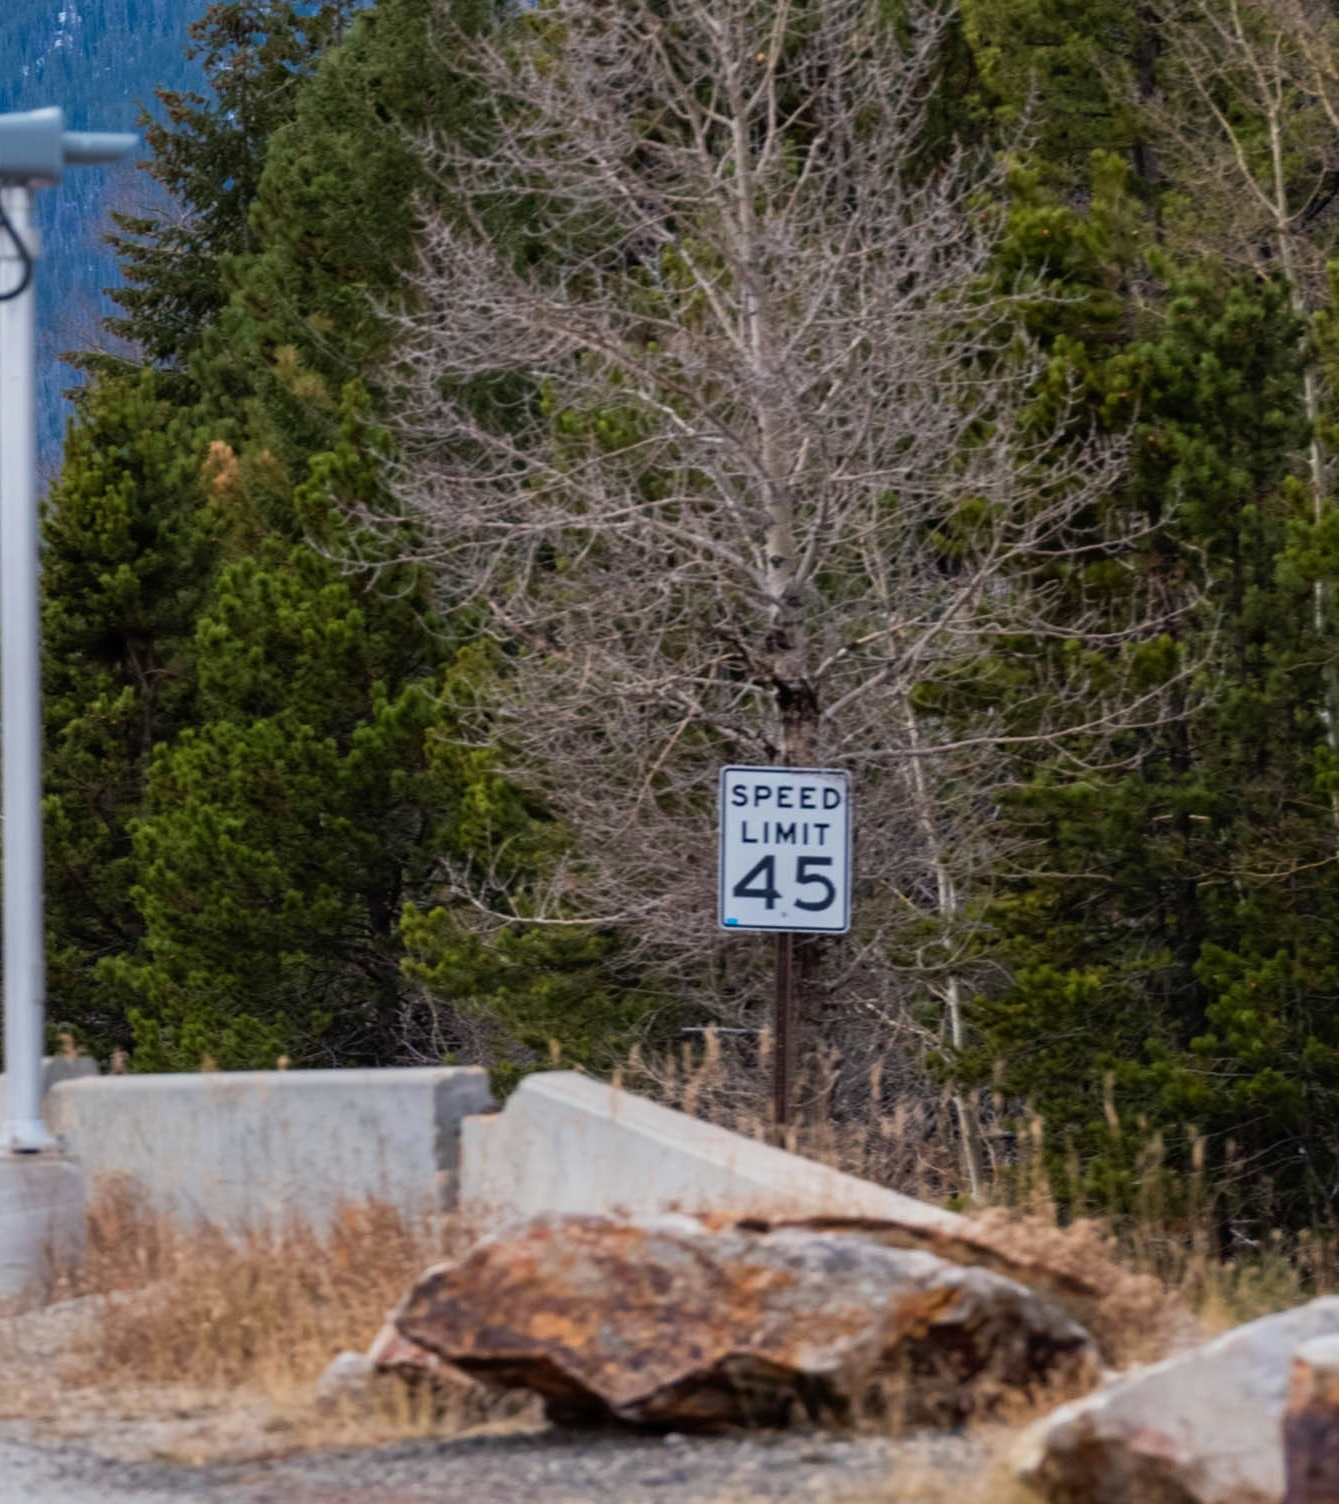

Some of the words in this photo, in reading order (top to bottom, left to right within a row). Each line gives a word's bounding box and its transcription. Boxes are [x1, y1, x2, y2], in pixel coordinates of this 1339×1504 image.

[731, 784, 841, 810] SPEED
[741, 821, 830, 845] LIMIT
[732, 854, 837, 912] 45
